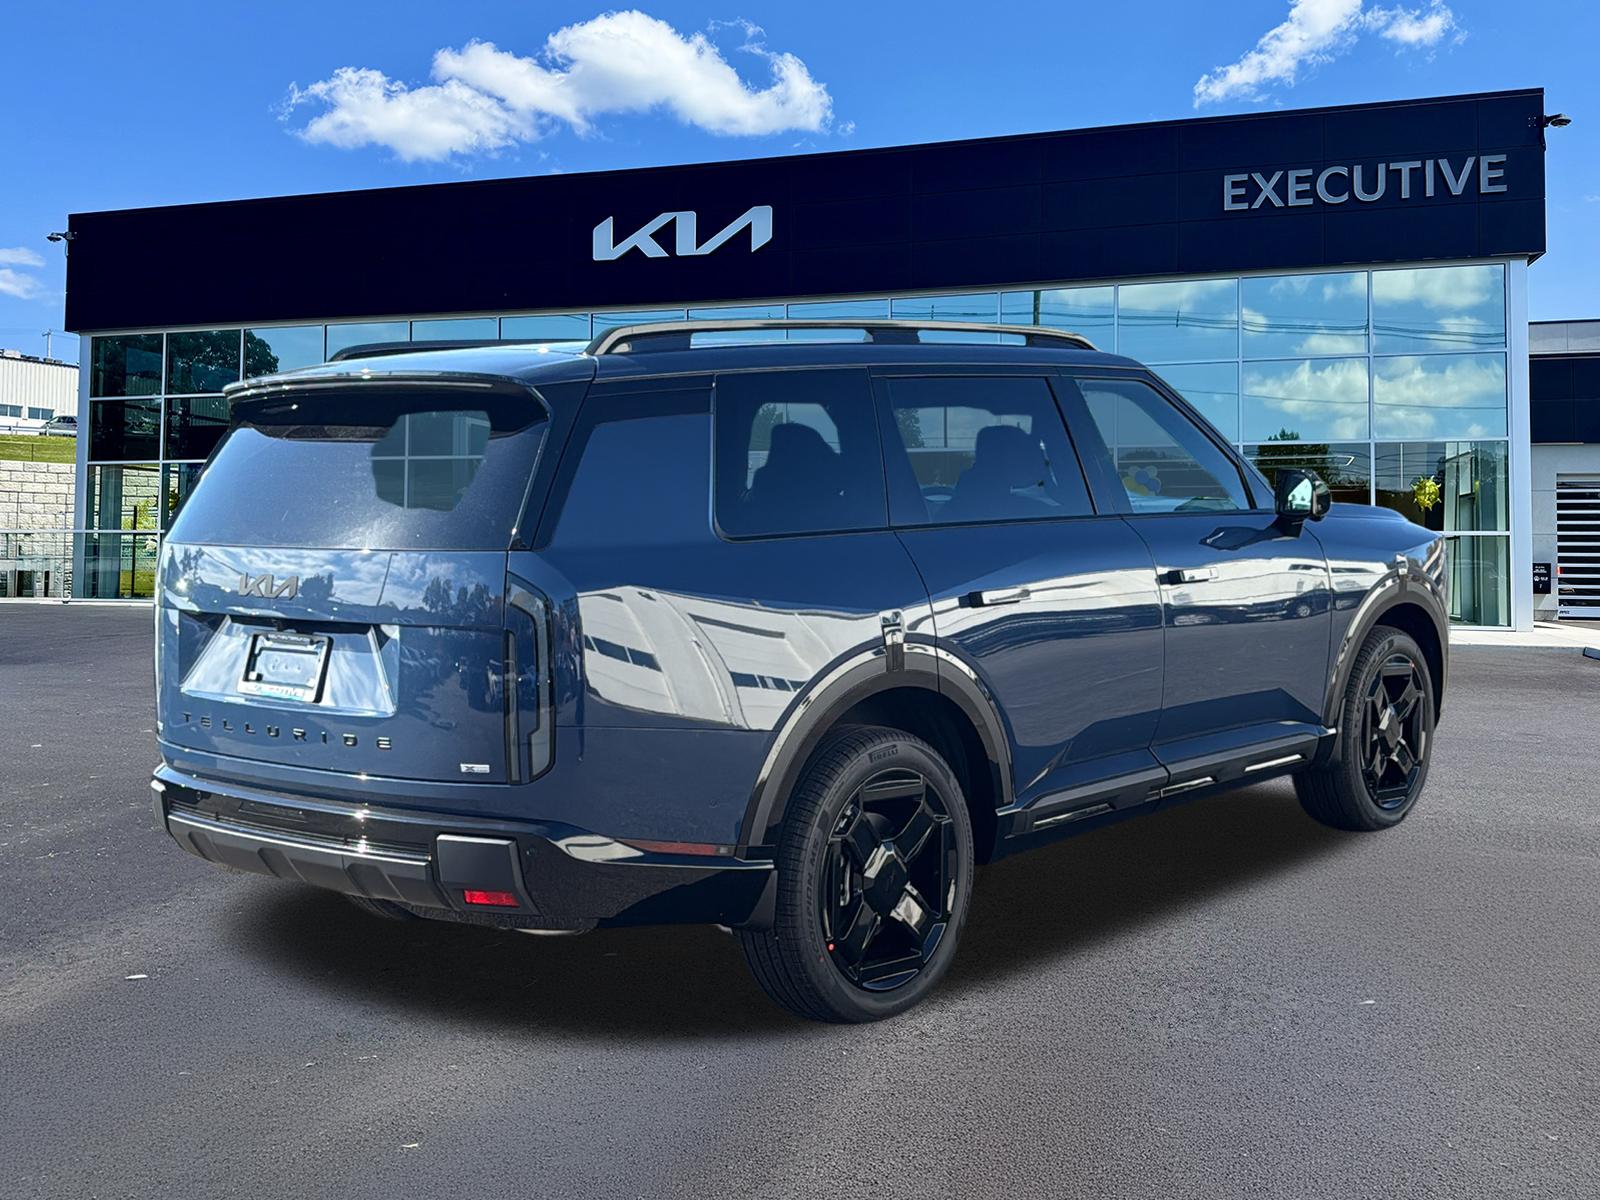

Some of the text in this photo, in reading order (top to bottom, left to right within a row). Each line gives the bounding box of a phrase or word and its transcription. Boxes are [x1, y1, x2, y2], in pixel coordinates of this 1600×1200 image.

[1223, 154, 1508, 211] EXECUTIVE
[592, 205, 773, 261] KIA
[238, 572, 299, 600] KIA
[182, 712, 393, 751] TELLURIDE
